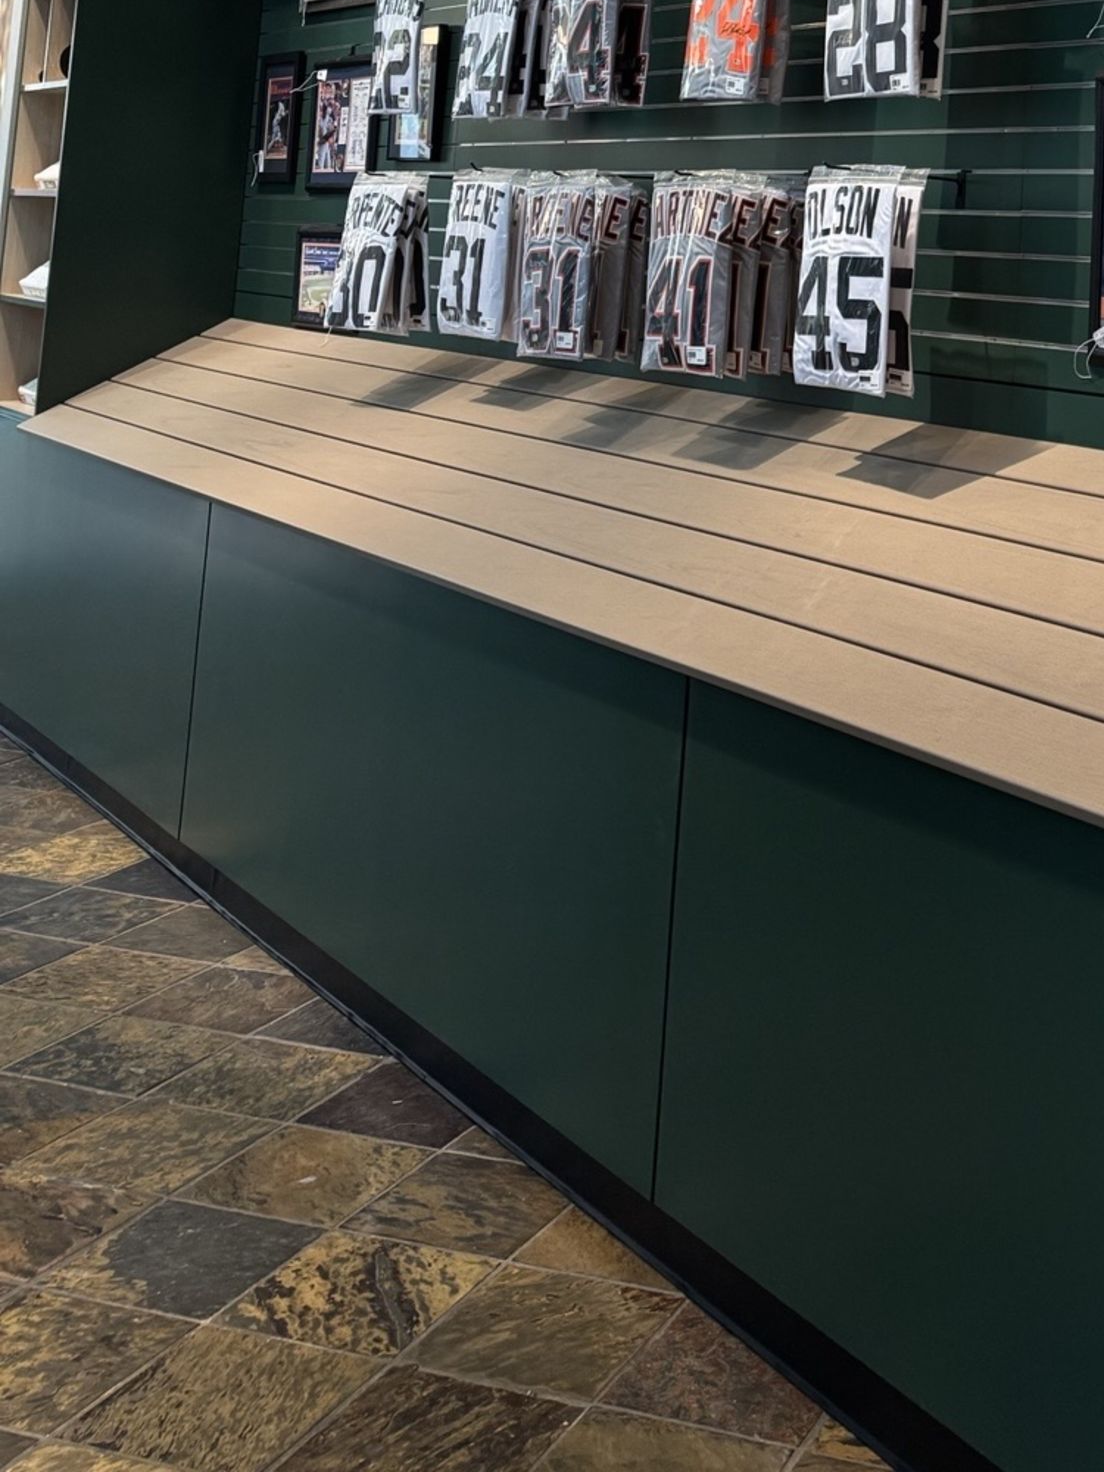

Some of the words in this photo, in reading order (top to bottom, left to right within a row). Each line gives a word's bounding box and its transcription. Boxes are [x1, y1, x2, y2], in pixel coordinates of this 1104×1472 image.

[806, 184, 881, 241] OLSON
[440, 234, 486, 327] 31
[521, 246, 582, 354] 31
[646, 255, 716, 374] 41
[796, 256, 884, 372] 45
